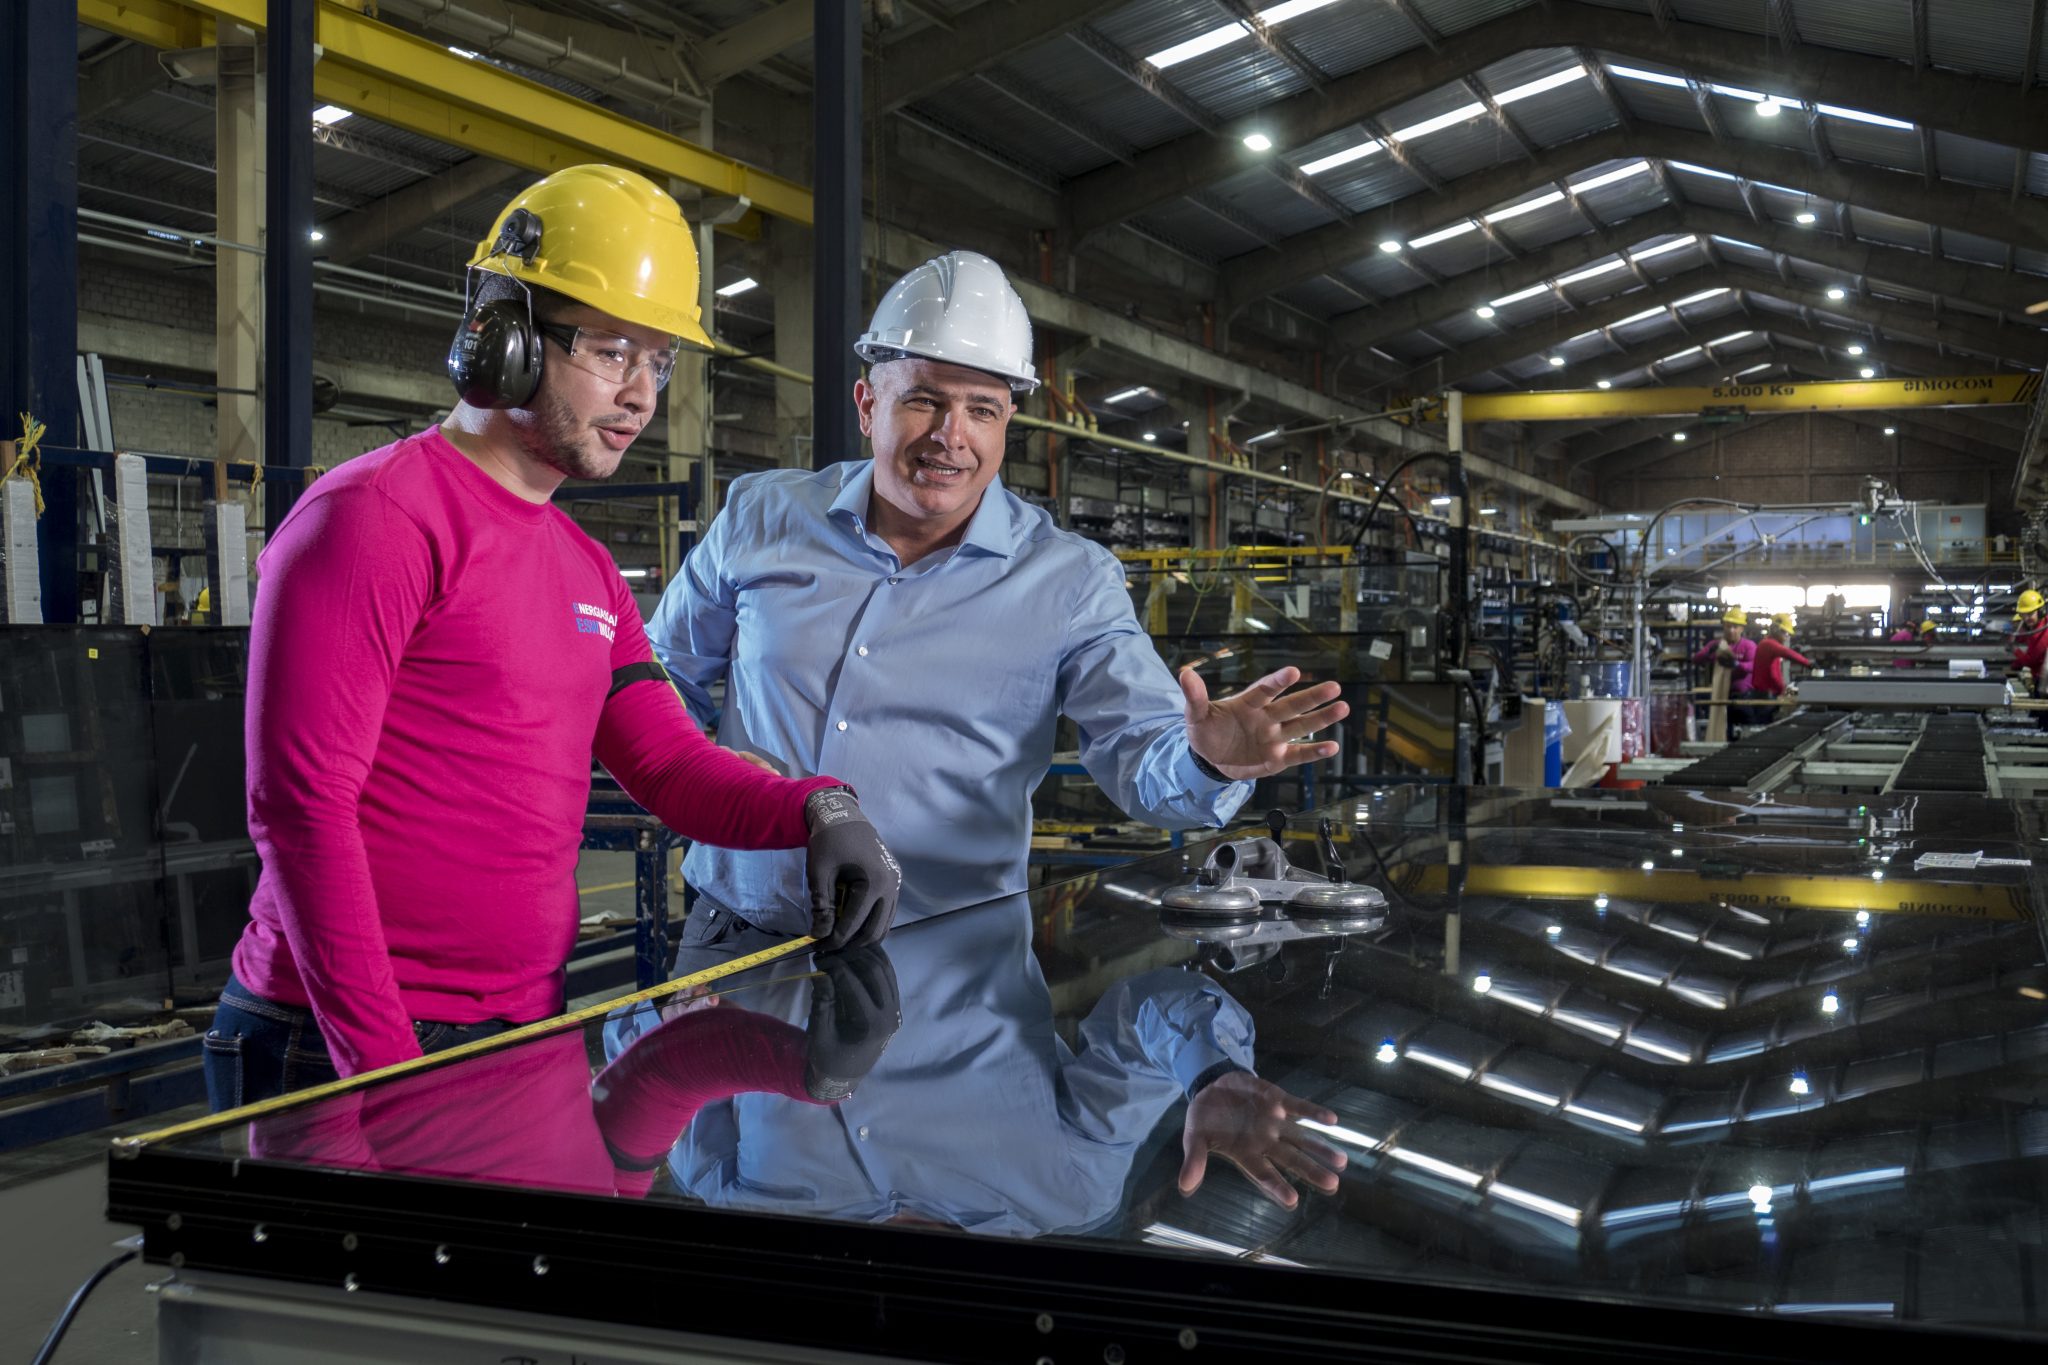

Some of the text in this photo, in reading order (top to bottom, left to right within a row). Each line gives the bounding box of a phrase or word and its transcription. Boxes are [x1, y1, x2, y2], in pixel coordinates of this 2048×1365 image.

[464, 339, 478, 351] 101
[1712, 386, 1763, 398] 5.000
[823, 810, 849, 824] Ansell
